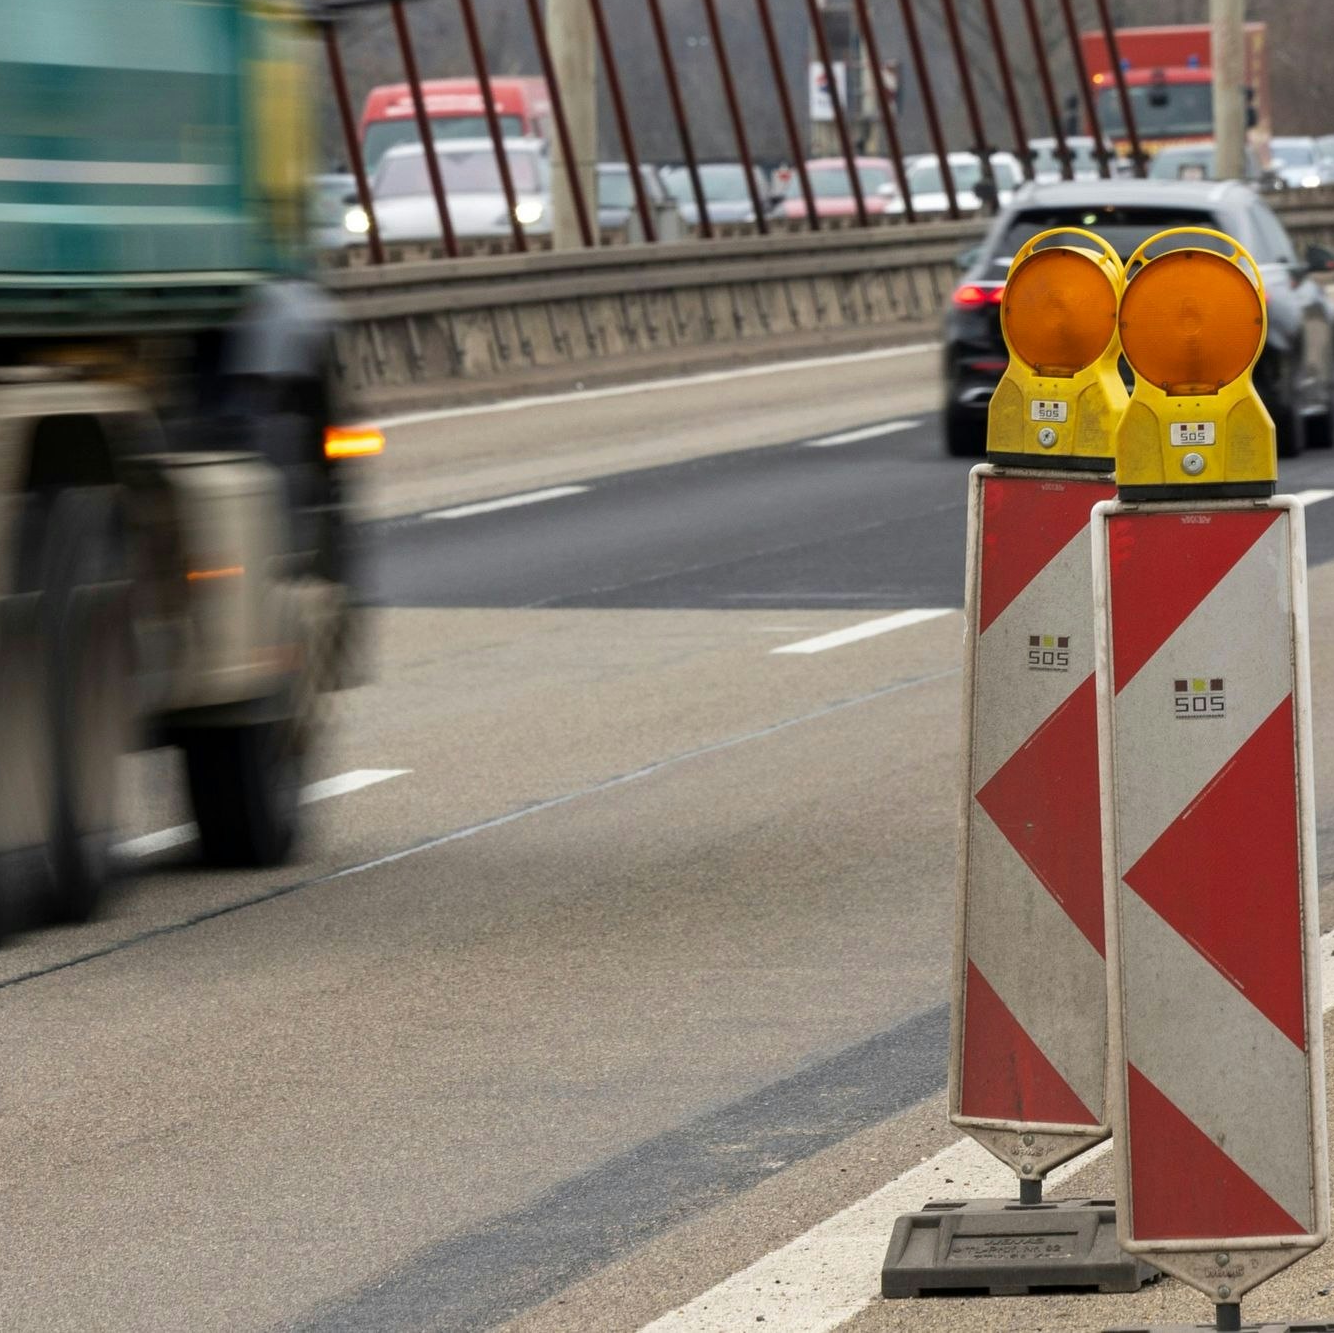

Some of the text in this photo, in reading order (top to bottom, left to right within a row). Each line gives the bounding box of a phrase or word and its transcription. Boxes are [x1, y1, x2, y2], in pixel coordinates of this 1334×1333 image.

[1038, 409, 1059, 418] SOS
[1180, 432, 1205, 442] SOS
[1029, 651, 1069, 665] SOS
[1175, 696, 1224, 712] SOS
